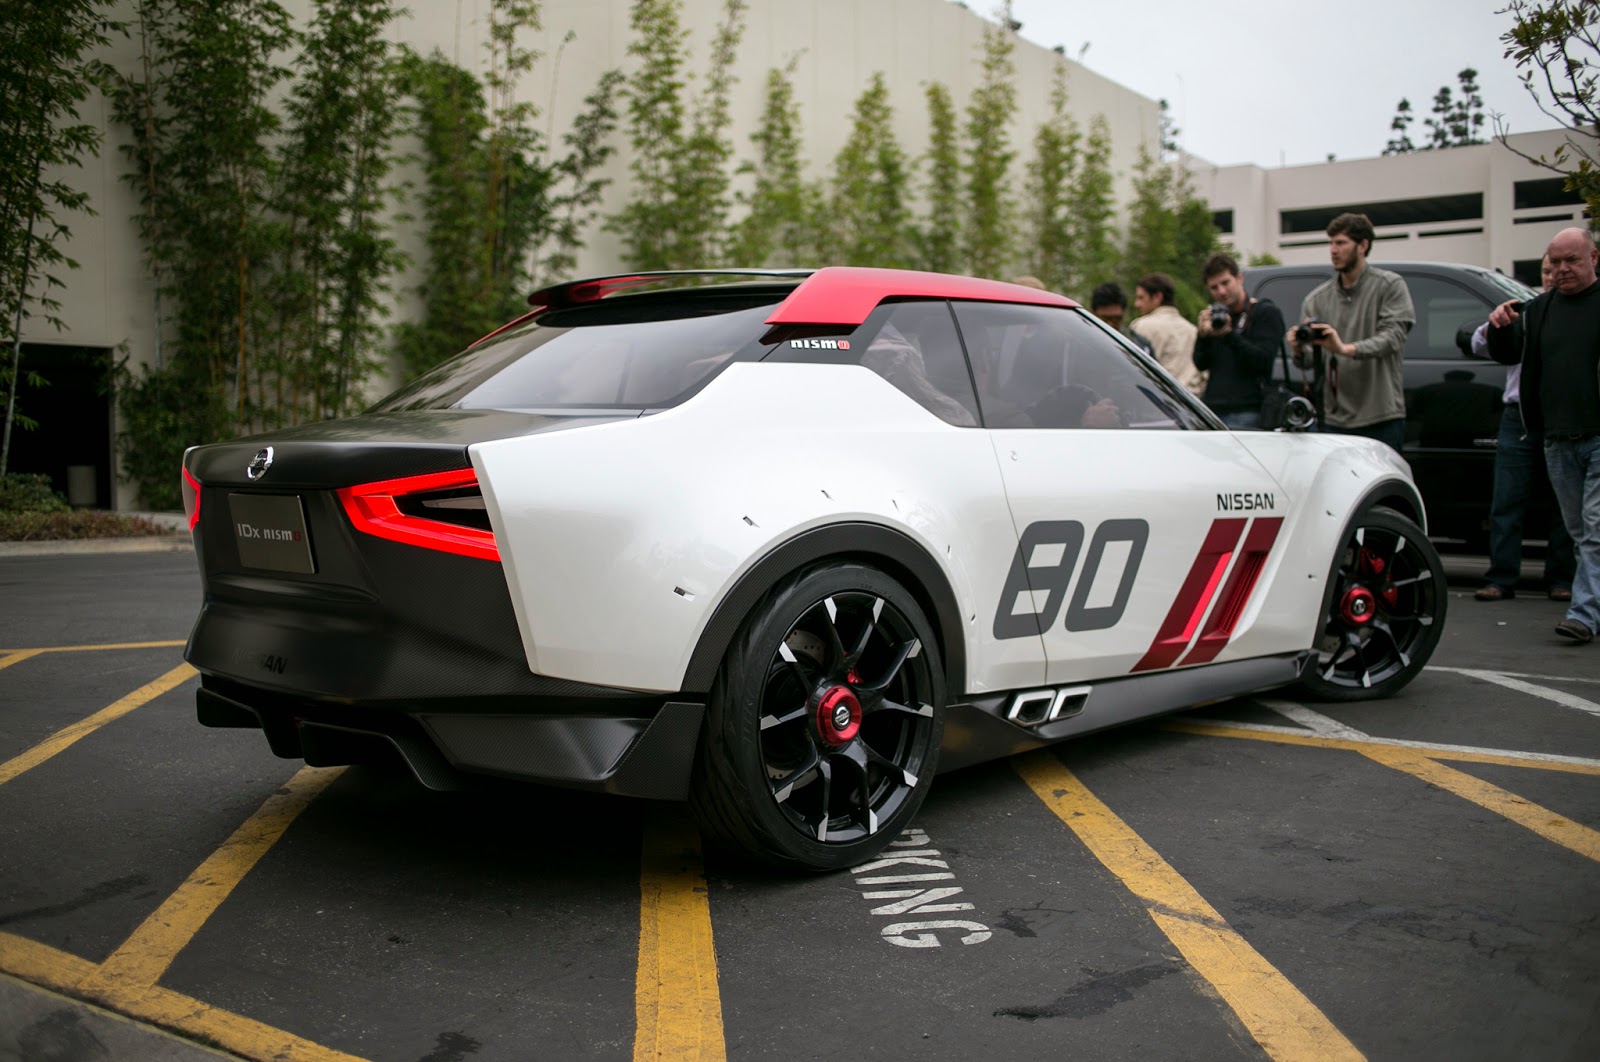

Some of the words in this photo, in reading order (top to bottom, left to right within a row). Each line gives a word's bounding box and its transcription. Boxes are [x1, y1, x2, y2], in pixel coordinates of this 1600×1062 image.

[790, 339, 850, 350] nismo
[1216, 493, 1275, 511] NISSAN
[237, 523, 260, 539] IDx
[992, 518, 1150, 640] 80
[232, 647, 289, 675] NIAN
